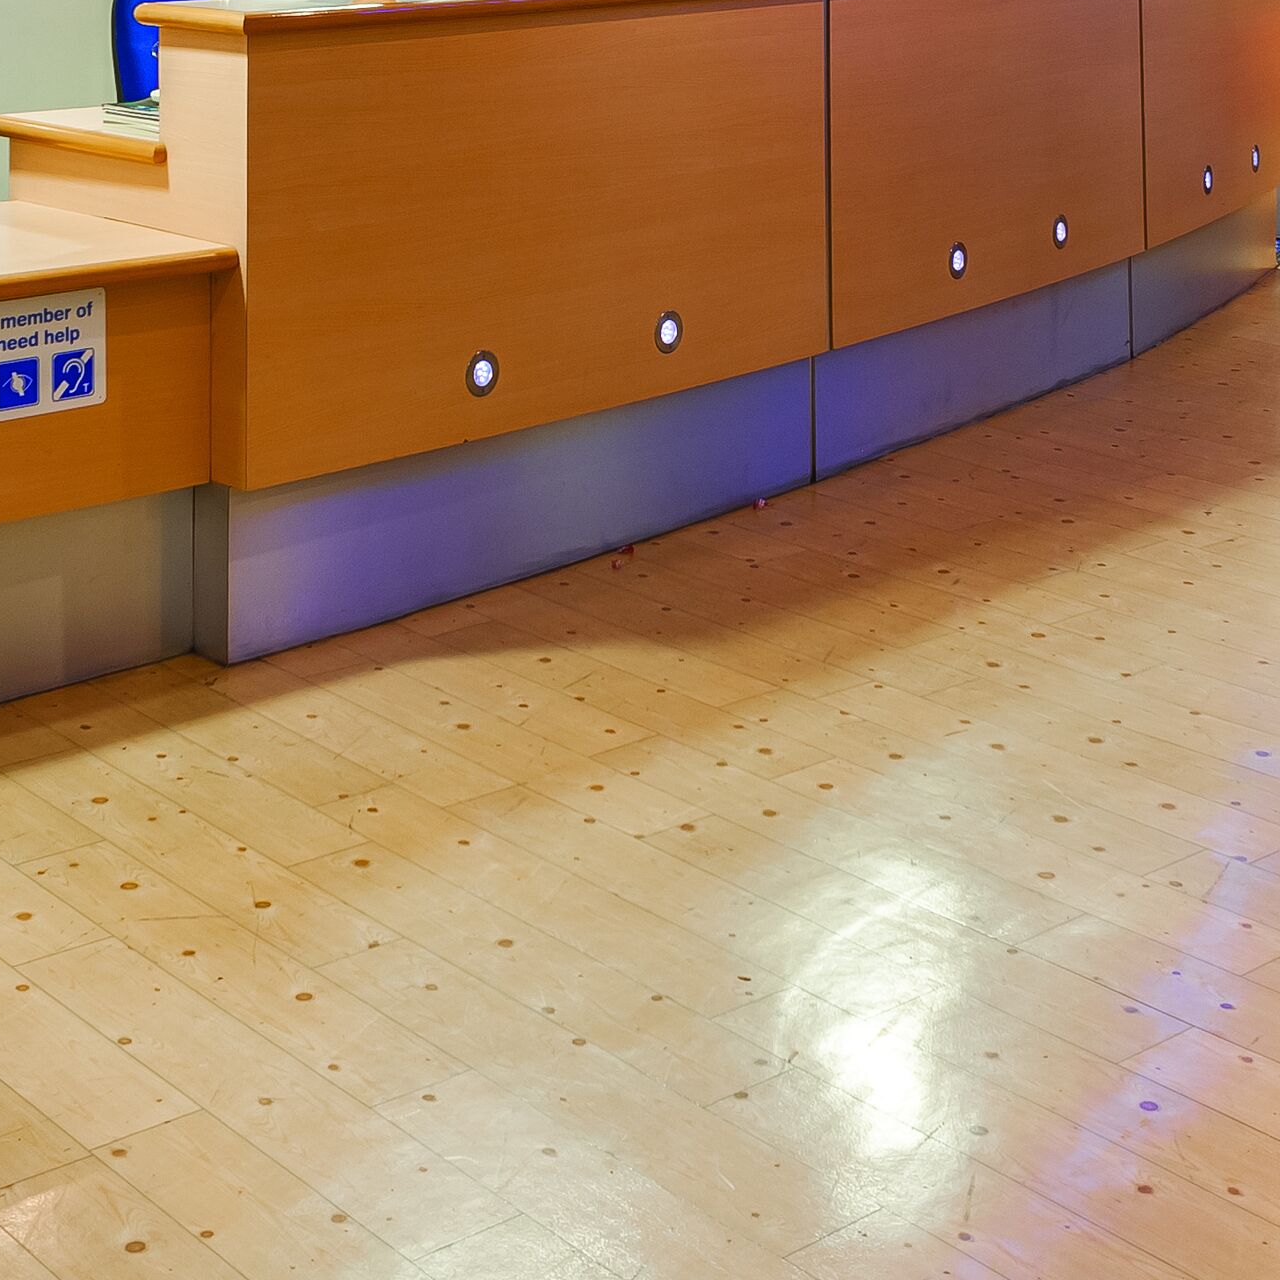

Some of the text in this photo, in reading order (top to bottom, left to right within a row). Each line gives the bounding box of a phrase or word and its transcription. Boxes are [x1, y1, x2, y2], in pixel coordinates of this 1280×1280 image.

[0, 306, 72, 330] member
[76, 300, 94, 318] of
[44, 326, 81, 346] help
